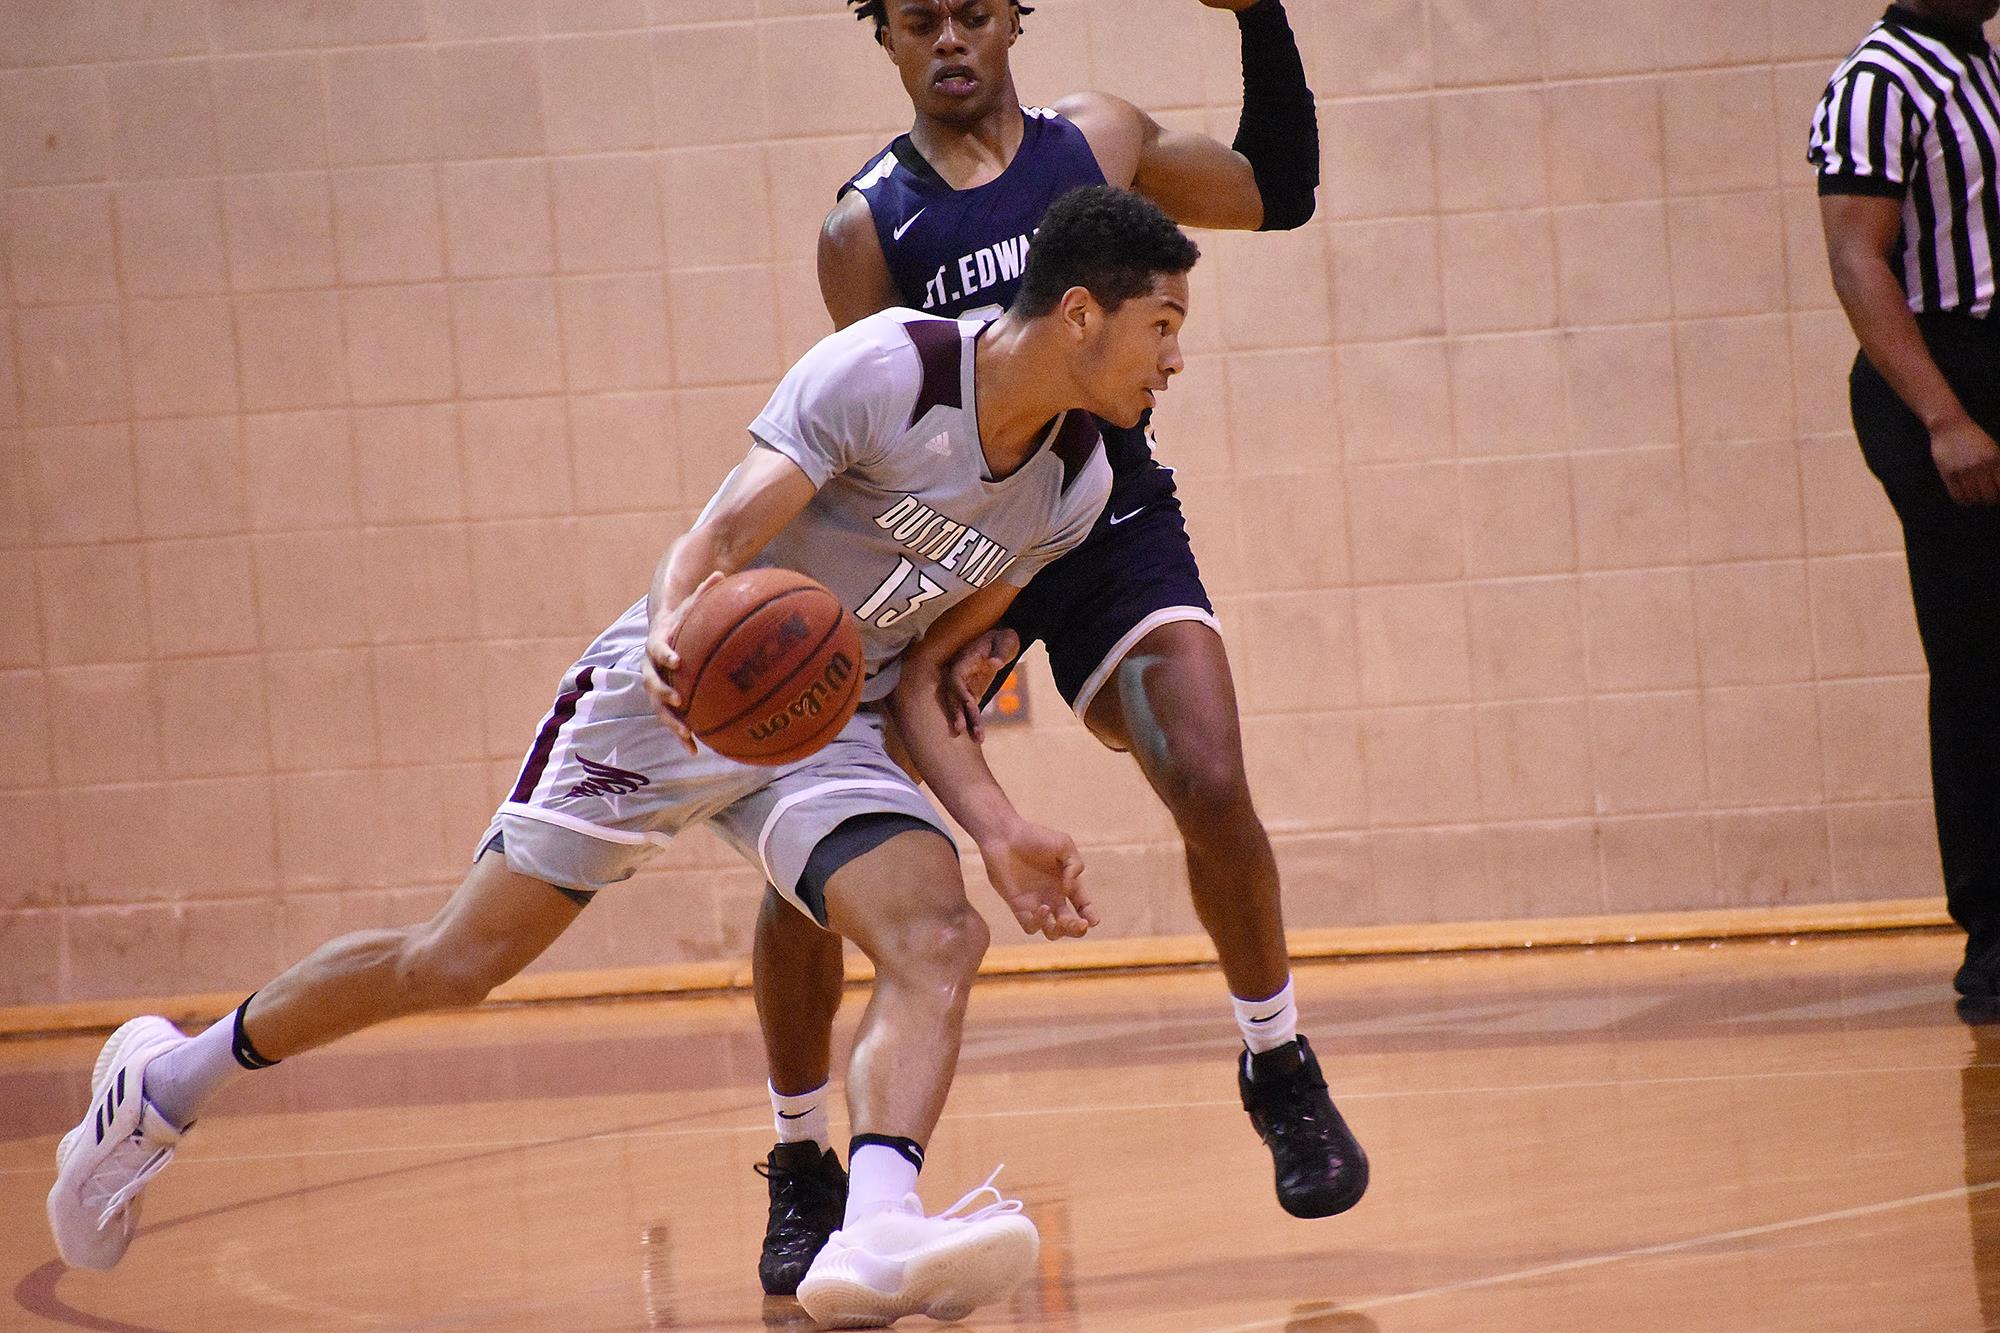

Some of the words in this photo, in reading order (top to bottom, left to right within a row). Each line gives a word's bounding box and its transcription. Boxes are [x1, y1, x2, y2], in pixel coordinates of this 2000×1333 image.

[957, 226, 1040, 296] EDWA
[854, 555, 948, 629] 13
[749, 650, 852, 741] Wilson
